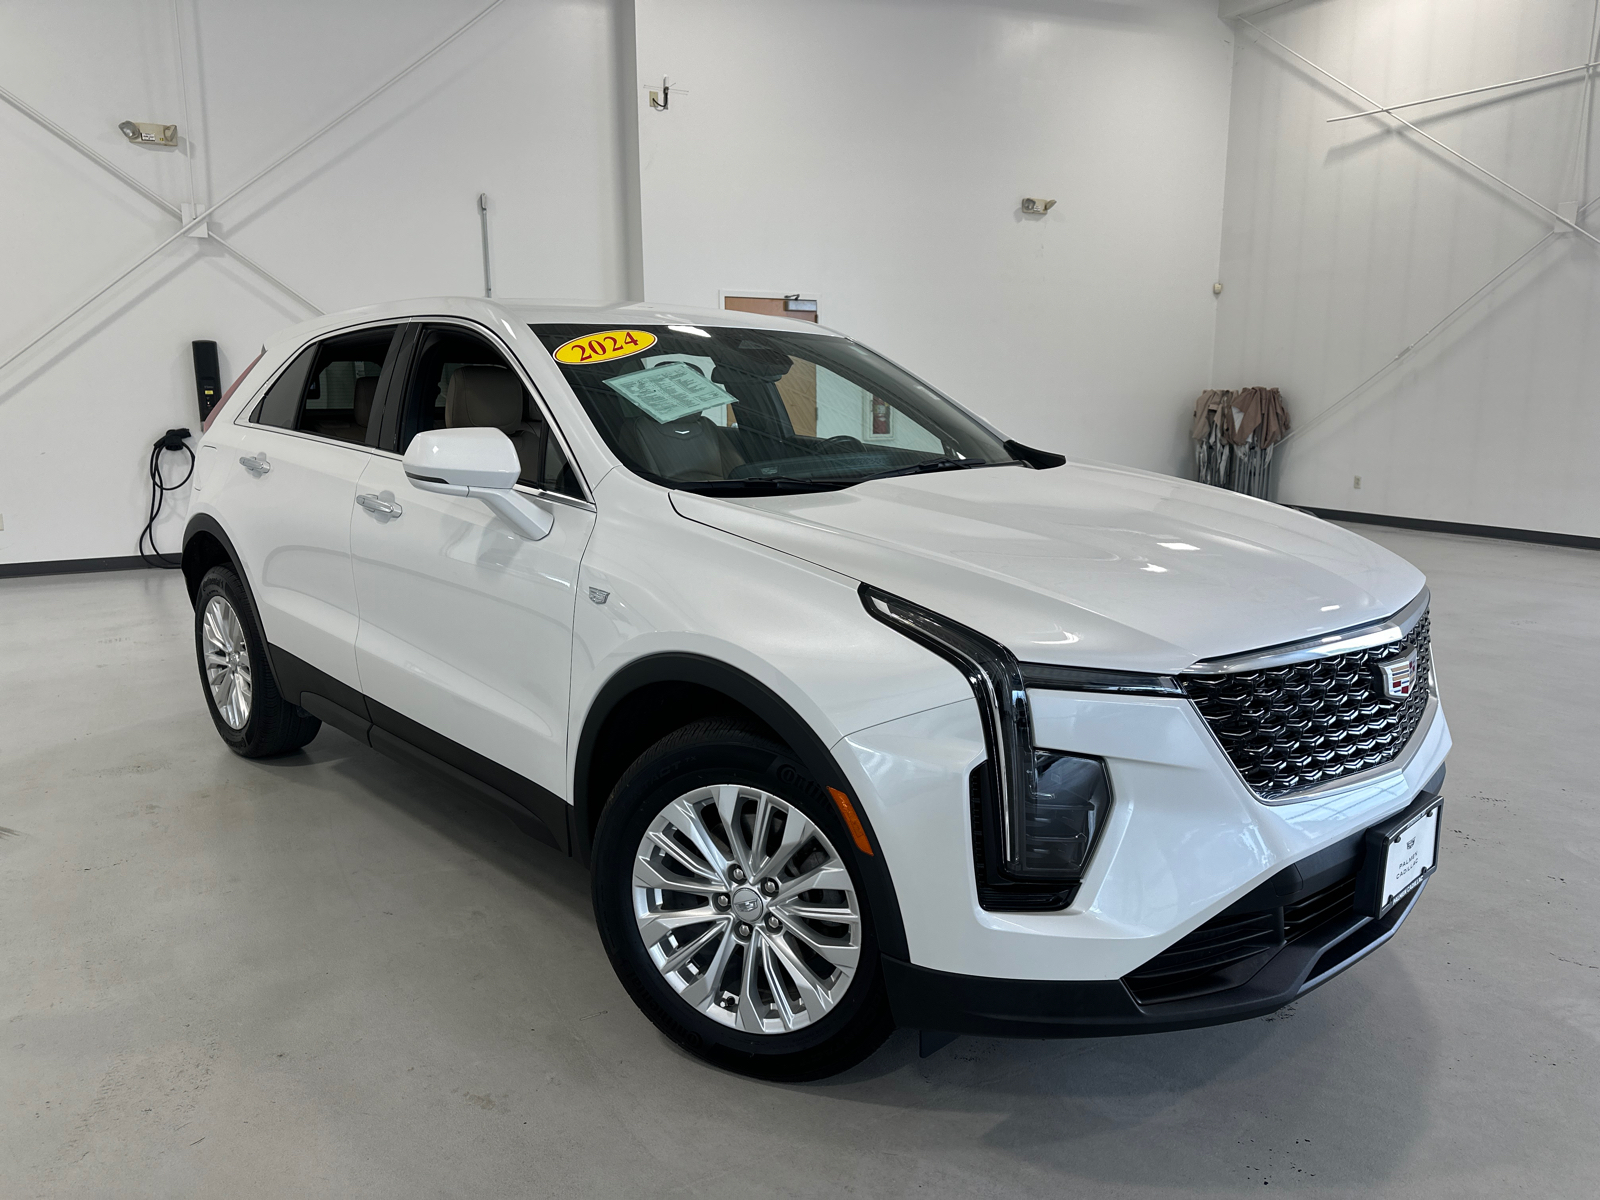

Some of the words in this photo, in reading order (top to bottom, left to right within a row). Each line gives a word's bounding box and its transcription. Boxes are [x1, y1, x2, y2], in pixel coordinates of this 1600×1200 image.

[571, 331, 639, 362] 2024
[1396, 858, 1419, 880] CADILLAC
[1399, 851, 1418, 869] PALMEN
